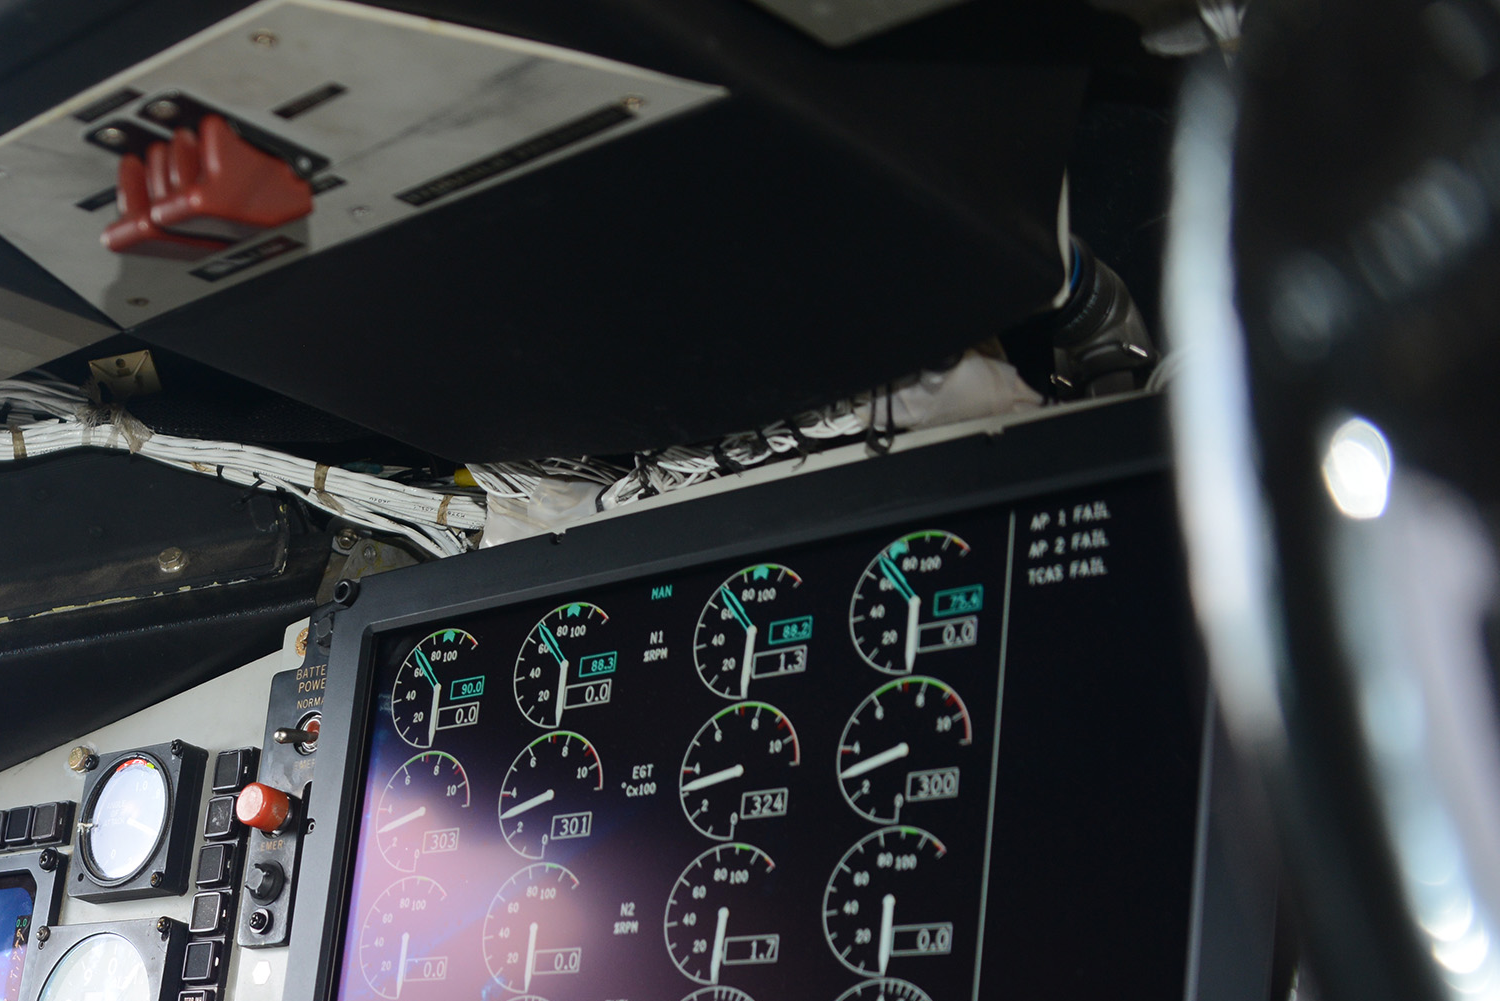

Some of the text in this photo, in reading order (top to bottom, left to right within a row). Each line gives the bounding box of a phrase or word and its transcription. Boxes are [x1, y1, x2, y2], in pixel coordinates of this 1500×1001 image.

[651, 585, 672, 599] MAN
[650, 631, 663, 644] N1
[943, 623, 974, 645] 0.0
[591, 658, 614, 672] 88.3
[779, 652, 805, 672] 1.3
[296, 664, 327, 681] BATTE
[298, 678, 326, 693] POWE
[461, 681, 482, 694] 90.0
[585, 683, 609, 702] 0.0
[455, 706, 476, 723] 0.0
[632, 764, 654, 779] EGT
[918, 773, 955, 798] 300
[751, 795, 783, 815] 324
[561, 816, 588, 835] 301
[431, 831, 456, 849] 303
[621, 902, 635, 916] N2
[917, 928, 948, 951] 0.0
[751, 940, 776, 960] 1.7
[423, 961, 445, 978] 0.0
[554, 953, 577, 970] 0.0
